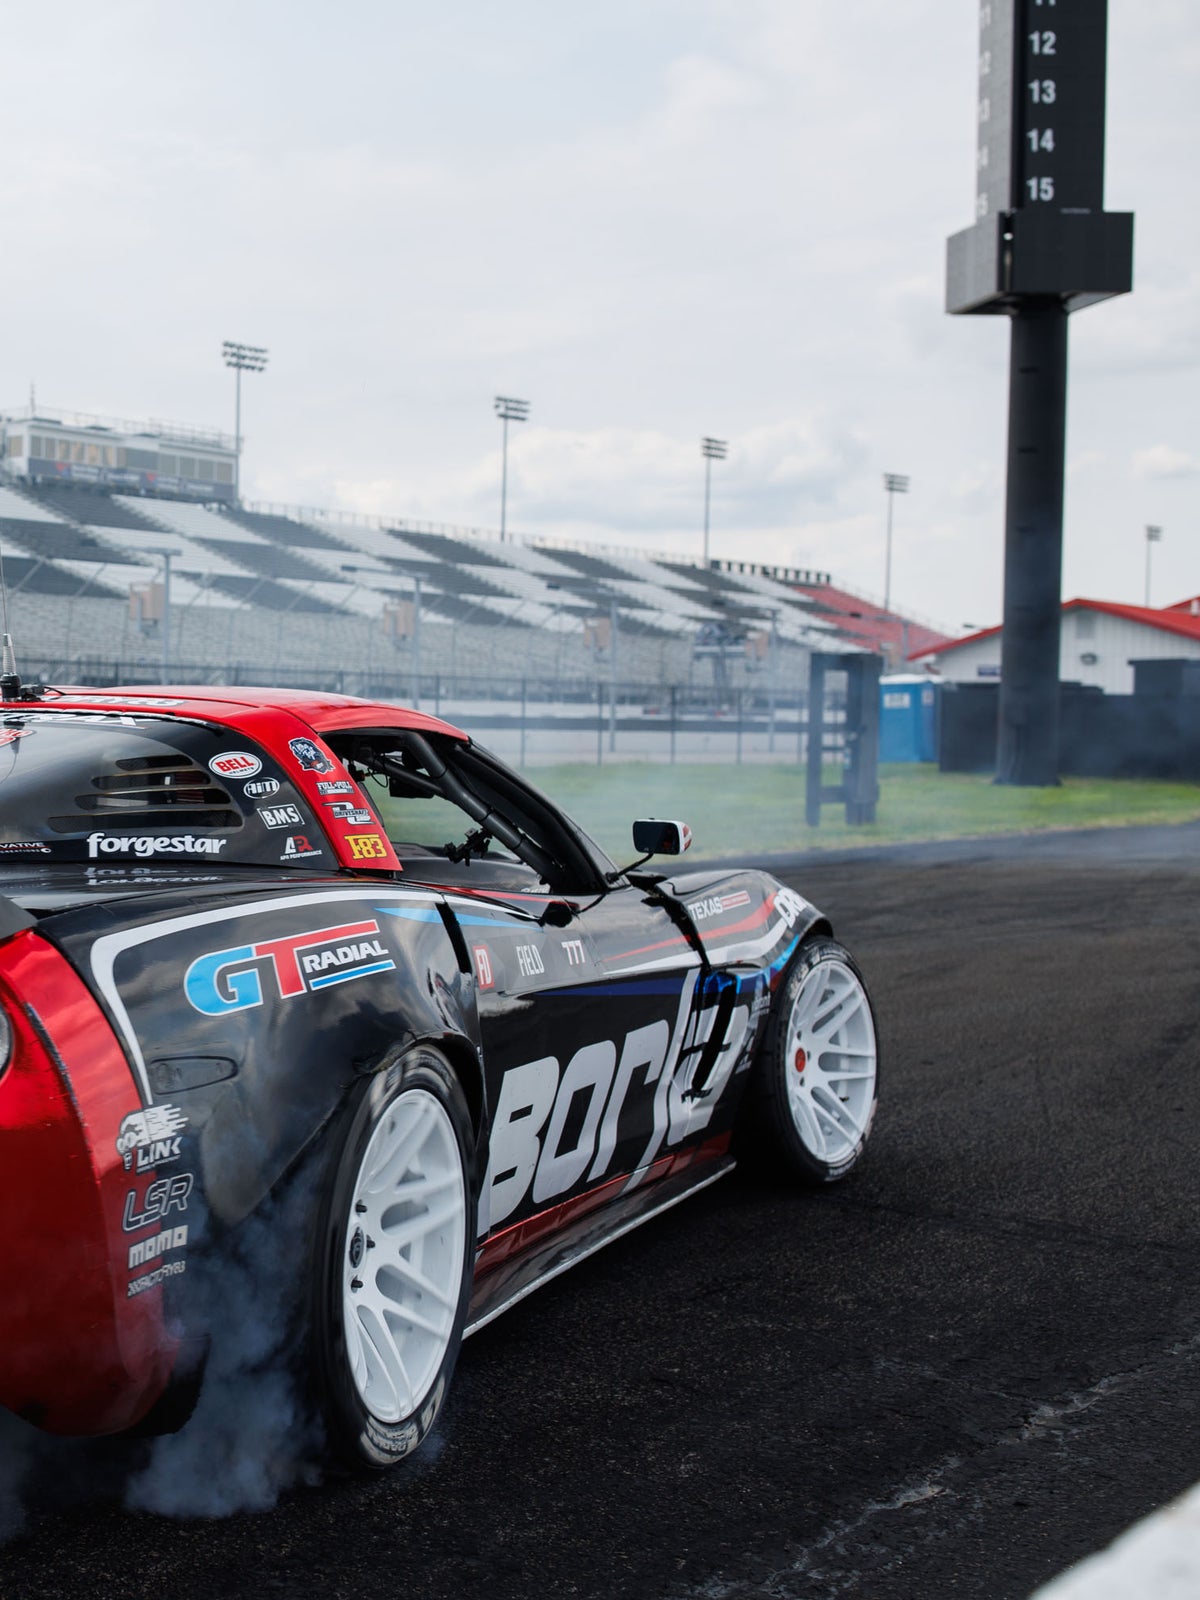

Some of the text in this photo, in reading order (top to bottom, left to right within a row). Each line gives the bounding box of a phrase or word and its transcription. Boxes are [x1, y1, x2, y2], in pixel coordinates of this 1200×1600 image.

[1028, 31, 1057, 55] 12
[1029, 79, 1057, 104] 13
[1026, 128, 1055, 152] 14
[1026, 177, 1054, 201] 15
[215, 756, 255, 773] BELL
[261, 807, 300, 826] BMS
[86, 832, 227, 858] forgestar
[688, 897, 723, 922] TEXAS
[515, 944, 545, 977] FIELD
[561, 939, 586, 966] 777
[183, 918, 389, 1017] GT RADIAL
[475, 948, 492, 986] FD
[136, 1136, 183, 1168] LINK
